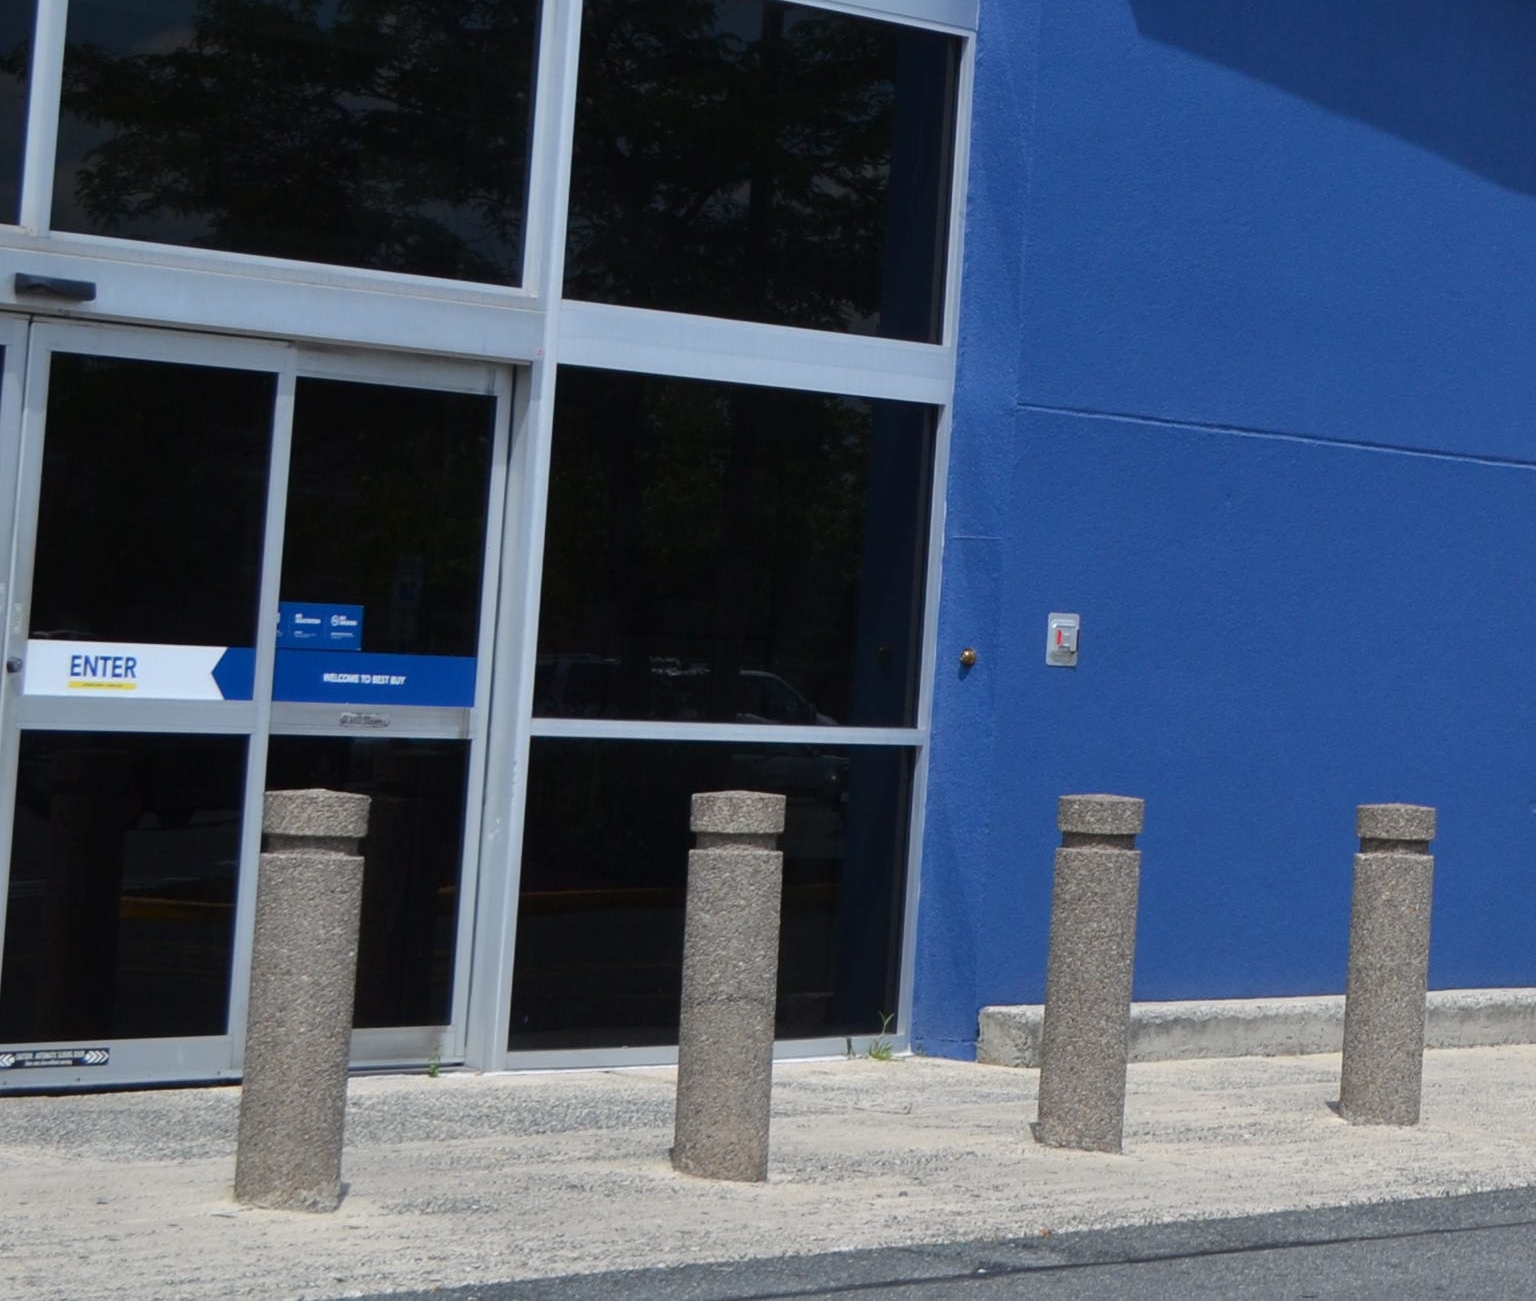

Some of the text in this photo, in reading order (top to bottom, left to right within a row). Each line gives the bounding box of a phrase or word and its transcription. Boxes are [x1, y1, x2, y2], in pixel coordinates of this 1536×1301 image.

[70, 655, 136, 678] ENTER
[323, 673, 407, 685] WELCOME TO BEST BUY
